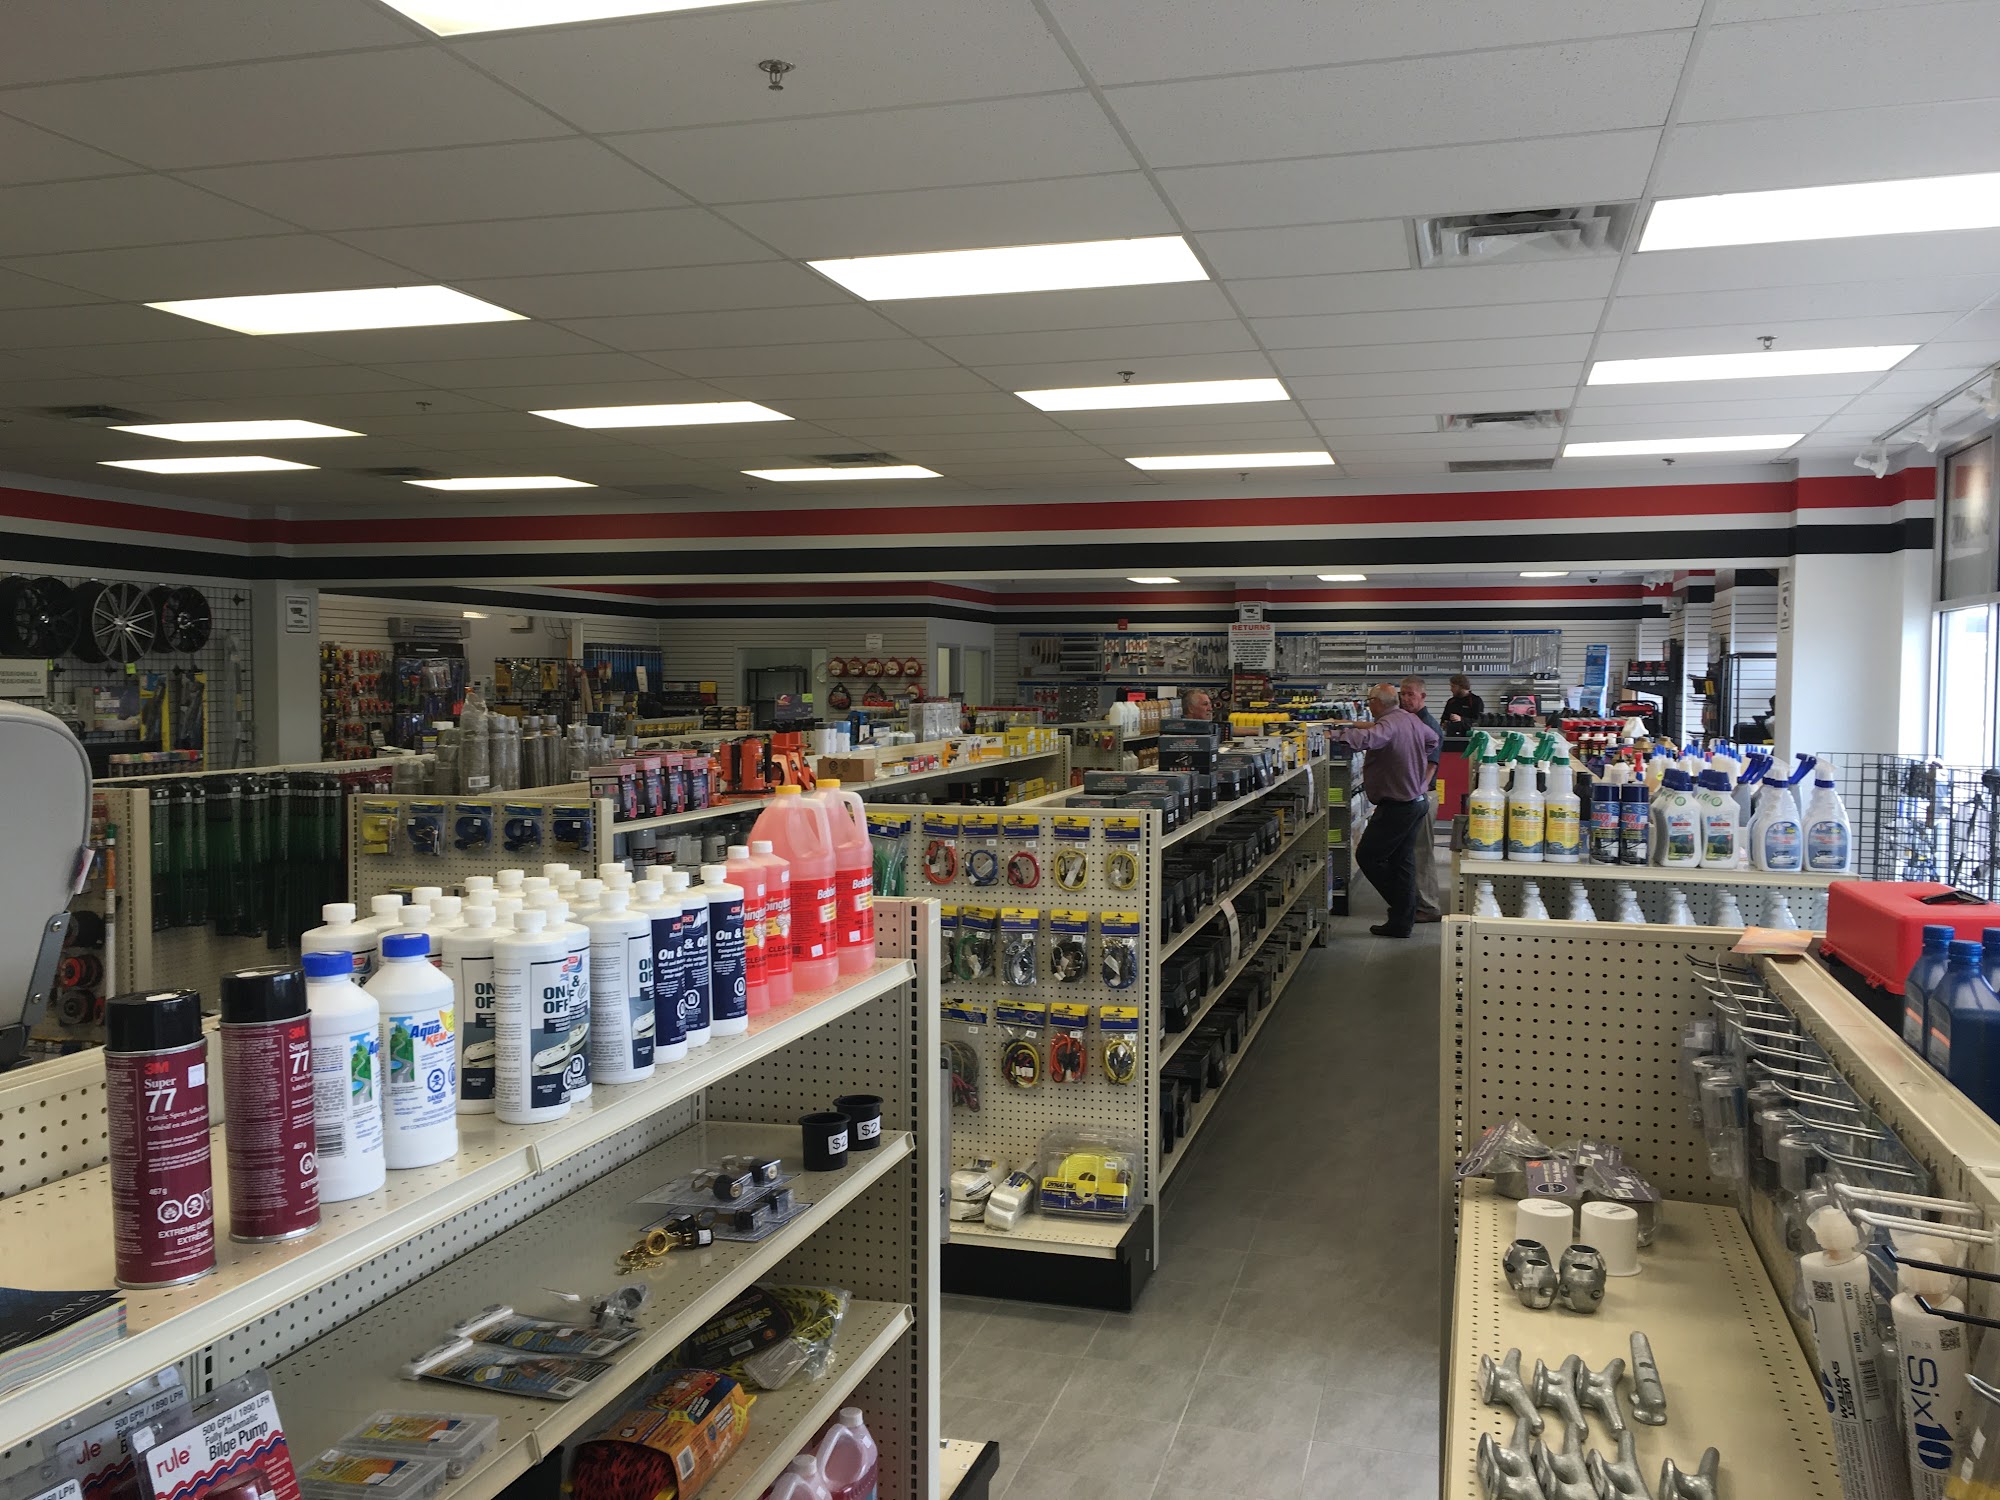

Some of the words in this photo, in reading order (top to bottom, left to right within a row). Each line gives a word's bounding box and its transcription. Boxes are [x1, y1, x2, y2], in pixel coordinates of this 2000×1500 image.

[715, 930, 731, 941] On
[734, 928, 742, 939] &
[683, 938, 694, 949] &
[658, 948, 675, 960] On
[572, 975, 580, 987] &
[639, 971, 653, 983] OF
[475, 982, 495, 995] ON
[543, 985, 565, 999] ON
[475, 996, 495, 1009] OF
[288, 1026, 306, 1039] 3M
[410, 1024, 442, 1041] Aqua-
[425, 1031, 447, 1048] KEM
[288, 1041, 309, 1052] Super
[144, 1061, 170, 1075] 3M
[289, 1050, 309, 1074] 77
[144, 1077, 176, 1090] Super
[144, 1088, 177, 1113] 77
[158, 1224, 196, 1239] EXTREME
[37, 1294, 101, 1323] 2016
[1831, 1360, 1849, 1418] SYSTEM
[1841, 1377, 1857, 1419] WEST
[114, 1415, 128, 1430] 500
[129, 1408, 145, 1422] GPH
[151, 1398, 169, 1412] 1890
[170, 1389, 184, 1404] LPH
[202, 1421, 216, 1436] 500
[217, 1413, 232, 1428] GPH
[239, 1402, 256, 1417] 1890
[257, 1394, 270, 1408] LPH
[1908, 1355, 1953, 1469] Six10
[204, 1431, 222, 1446] Fully
[224, 1413, 259, 1436] Automatic
[209, 1437, 237, 1461] Bilge
[238, 1421, 268, 1446] Pump
[156, 1447, 190, 1479] rule
[57, 1483, 76, 1500] LPH
